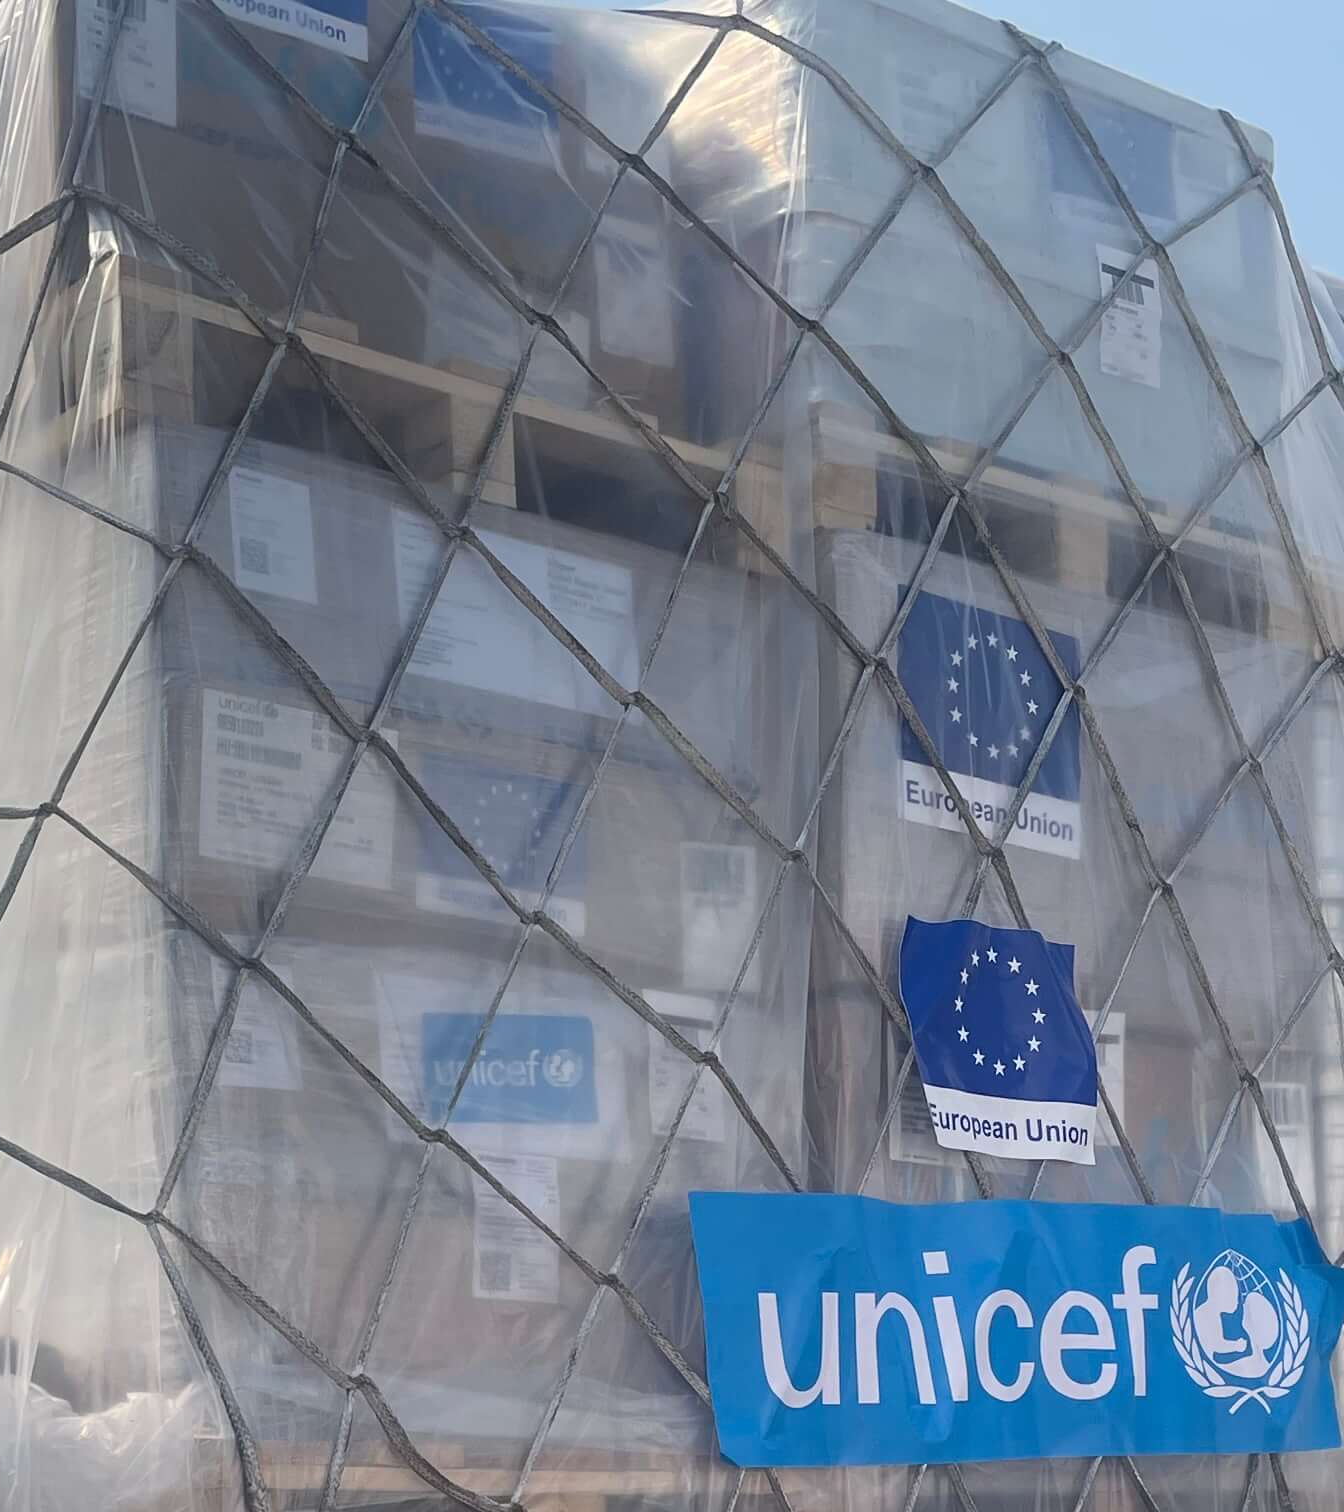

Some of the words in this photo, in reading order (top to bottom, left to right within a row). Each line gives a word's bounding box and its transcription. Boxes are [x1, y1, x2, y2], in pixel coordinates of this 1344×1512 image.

[295, 11, 347, 43] Union
[1015, 807, 1073, 841] Union
[928, 1102, 1018, 1141] European
[1026, 1118, 1089, 1147] Union
[757, 1244, 1159, 1409] unicef
